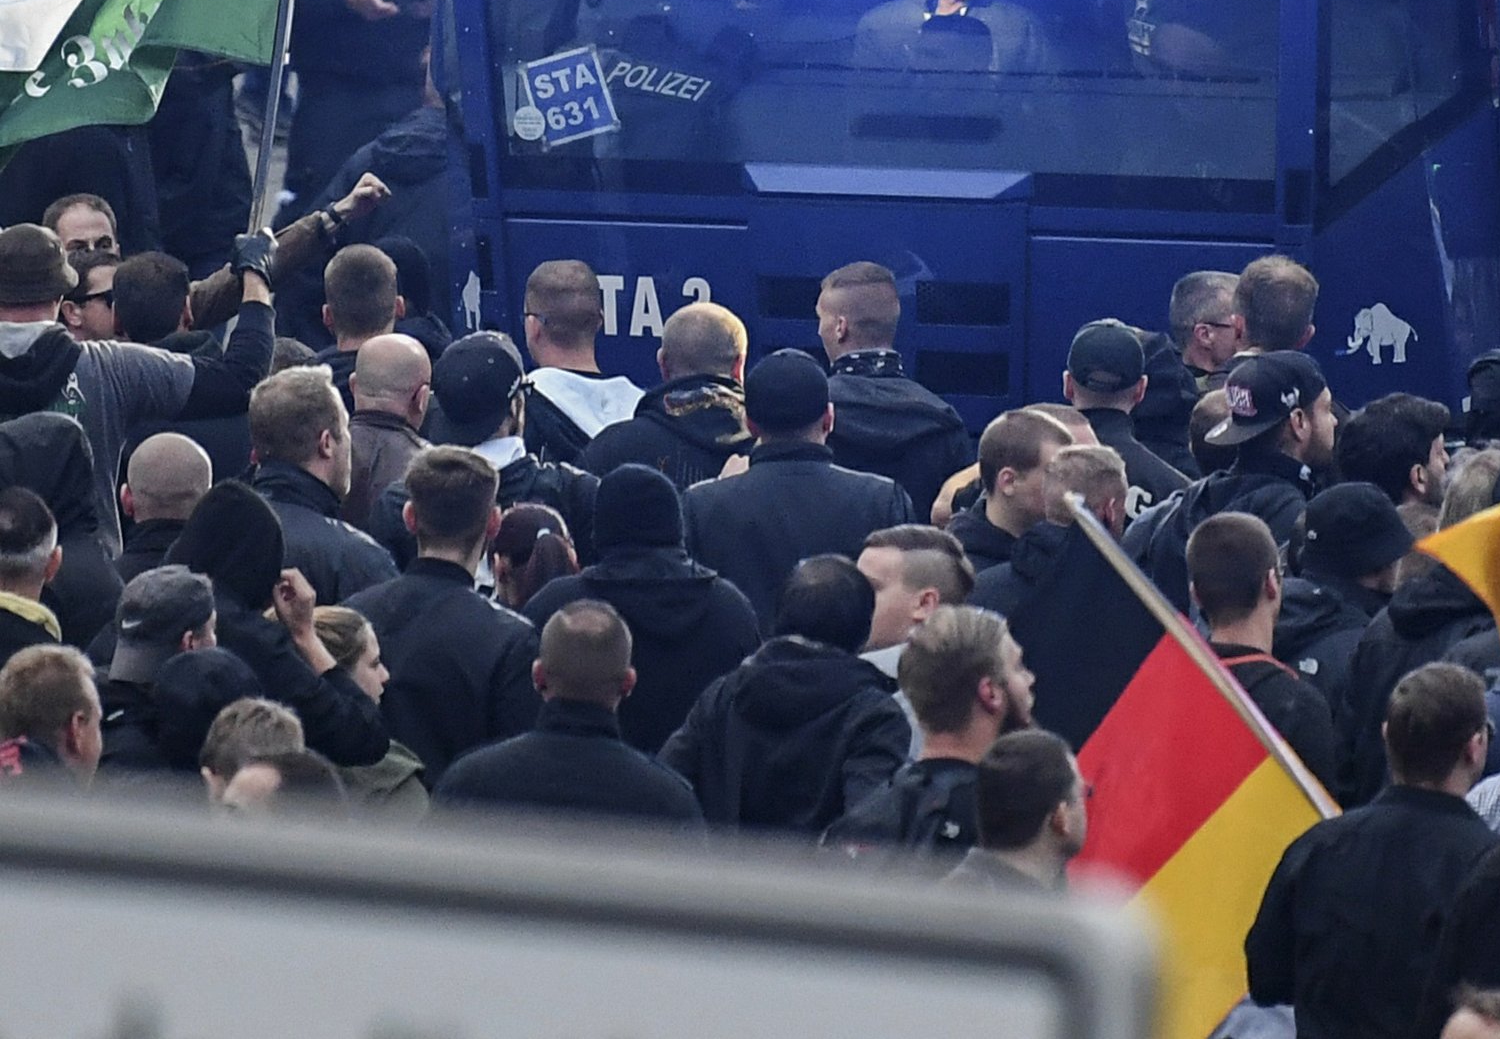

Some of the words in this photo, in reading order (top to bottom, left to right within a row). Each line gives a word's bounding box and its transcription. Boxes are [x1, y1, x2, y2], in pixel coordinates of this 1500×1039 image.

[534, 63, 597, 99] STA
[606, 61, 712, 102] POLIZEI
[546, 96, 600, 131] 631
[596, 274, 664, 337] TA
